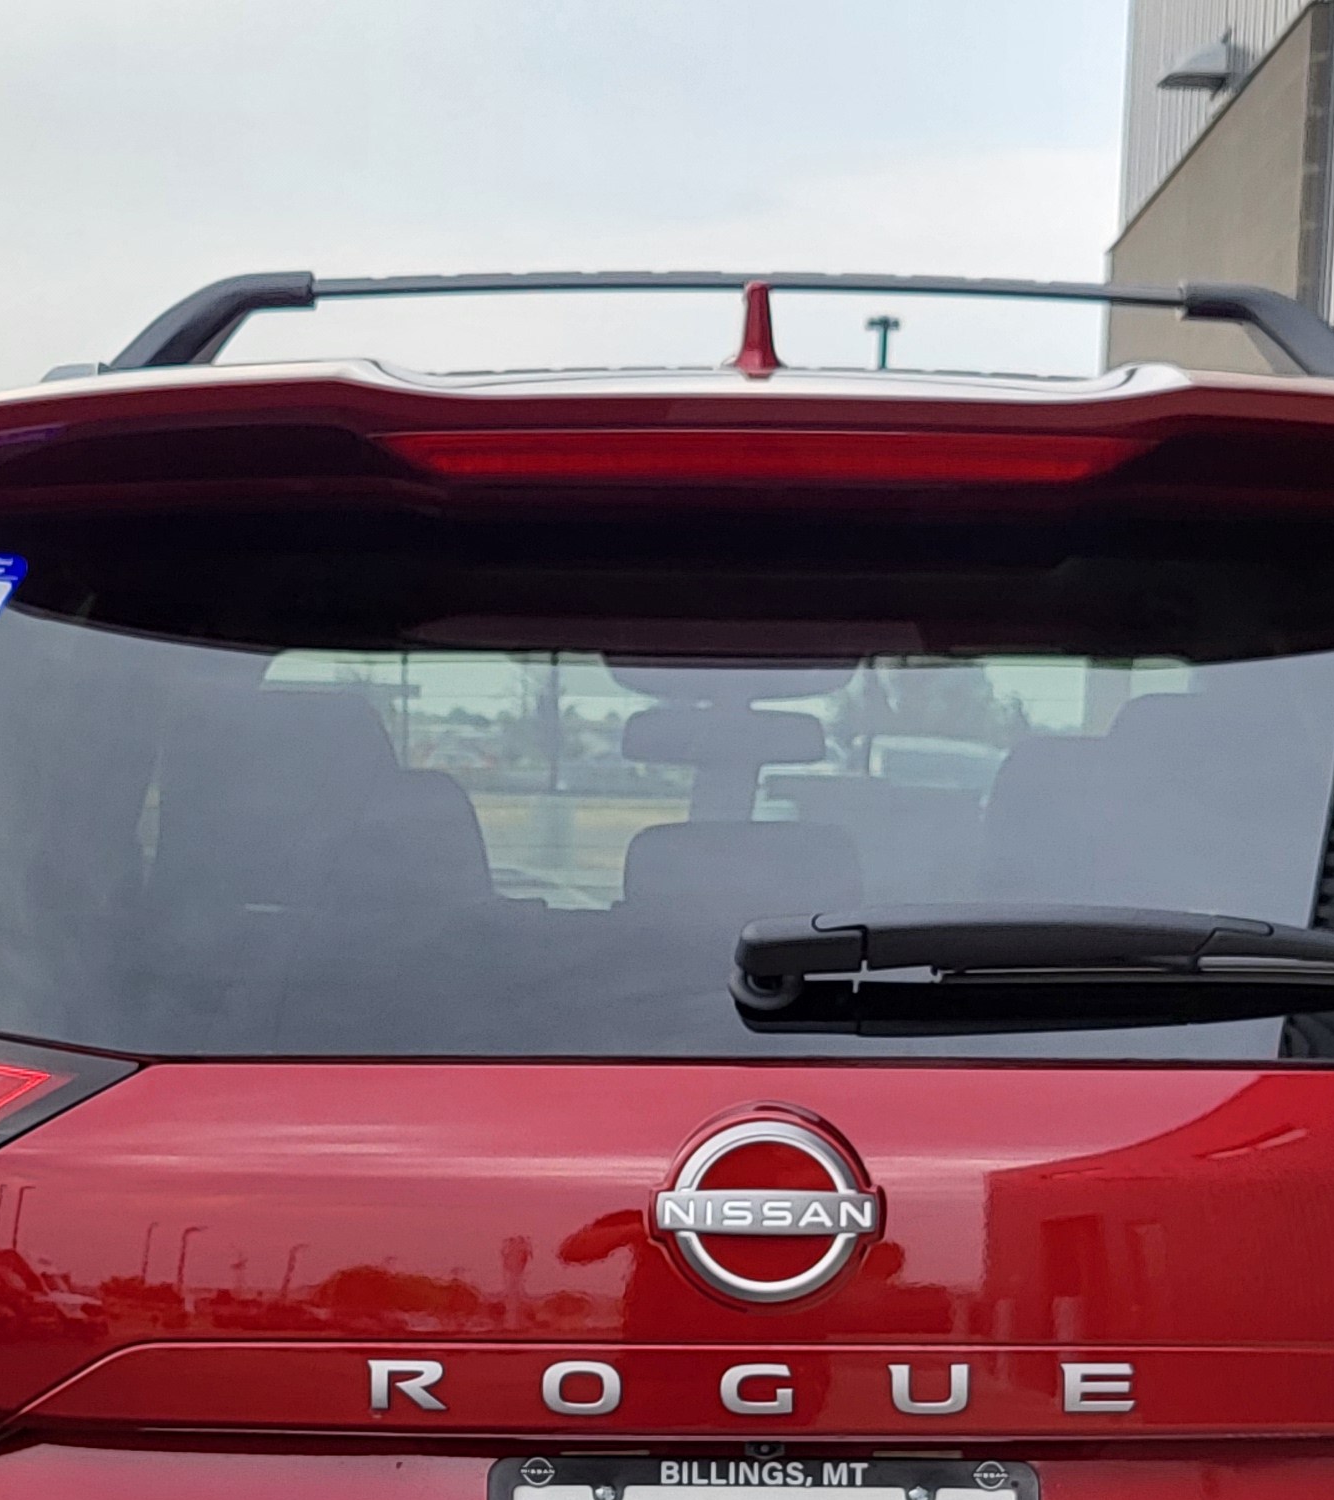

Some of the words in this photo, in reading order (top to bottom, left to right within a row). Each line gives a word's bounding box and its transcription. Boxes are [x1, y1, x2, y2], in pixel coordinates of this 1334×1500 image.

[664, 1200, 873, 1228] NISSAN
[367, 1359, 1135, 1416] ROGUE
[660, 1461, 813, 1487] BILLINGS,
[822, 1462, 869, 1486] MT
